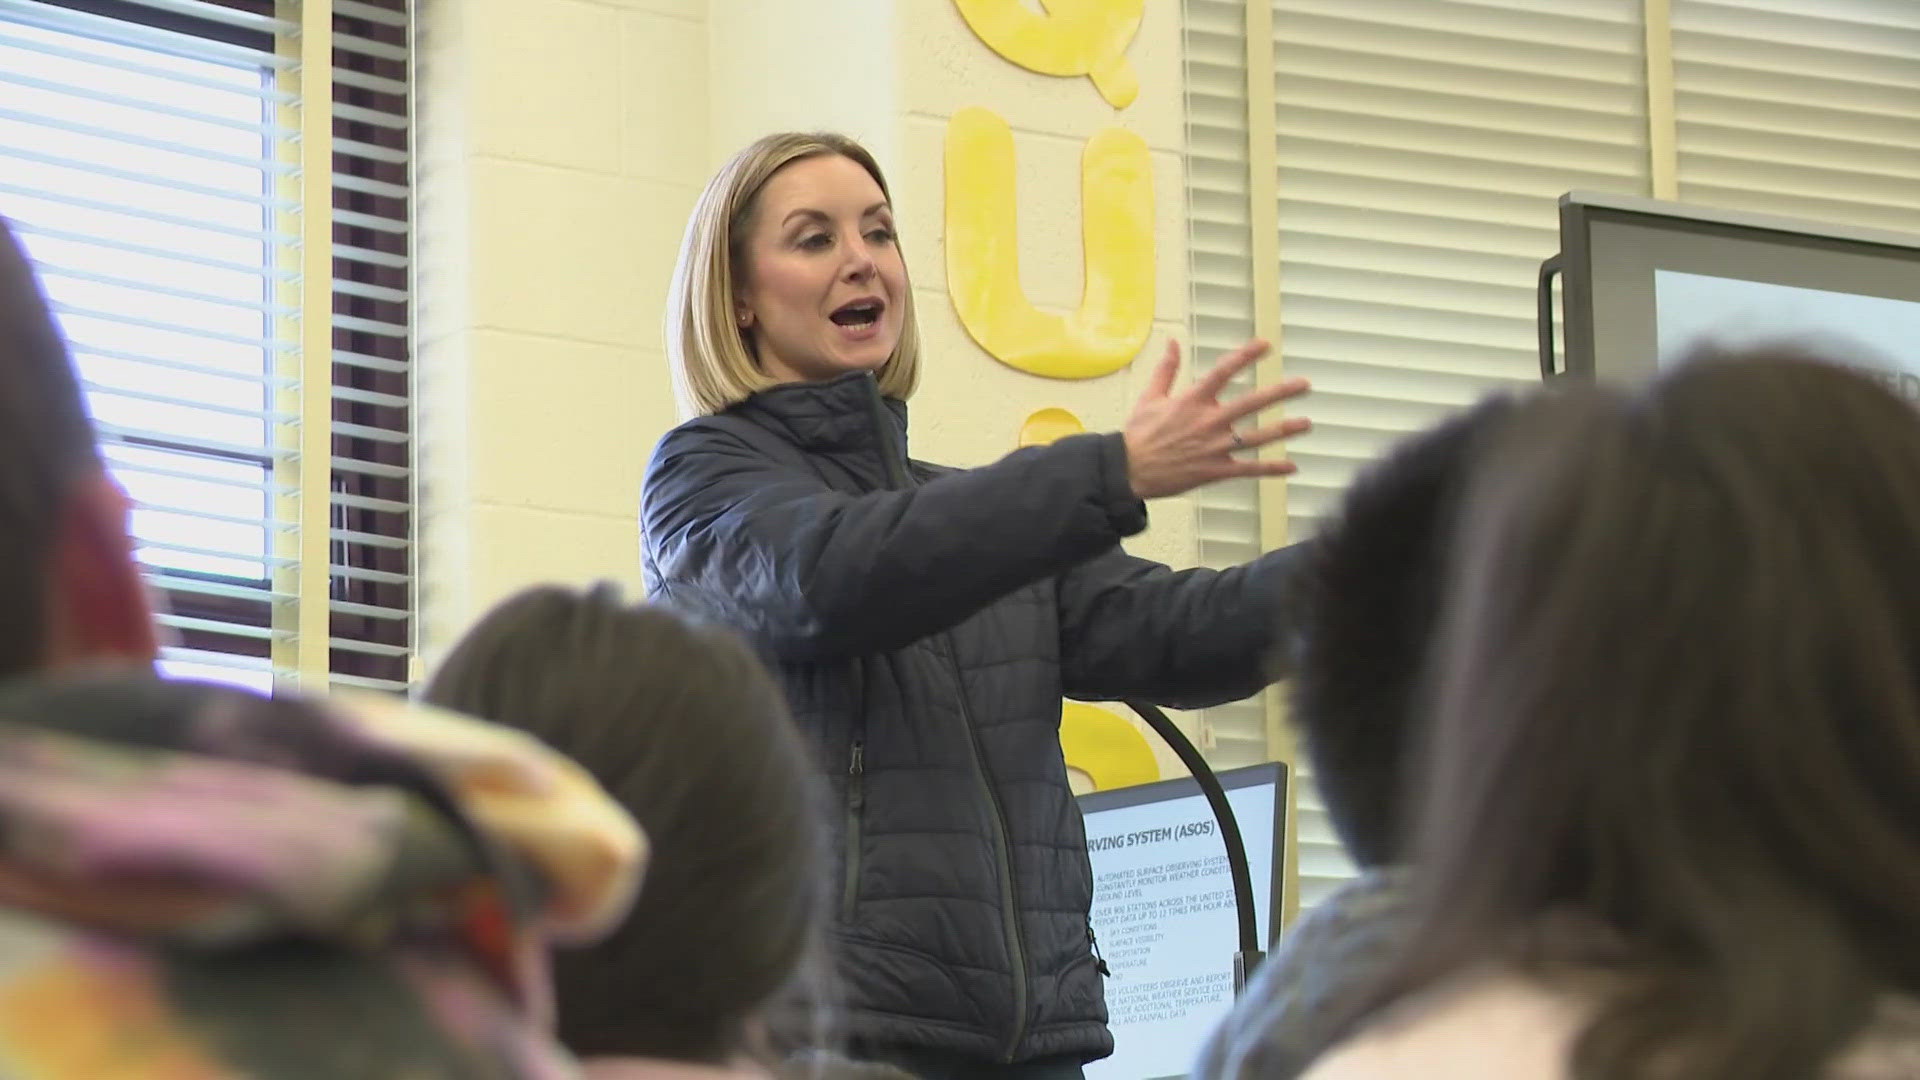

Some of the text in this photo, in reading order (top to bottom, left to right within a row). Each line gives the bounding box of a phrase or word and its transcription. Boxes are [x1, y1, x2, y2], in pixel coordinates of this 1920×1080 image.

[1127, 827, 1172, 847] SYSTEM
[1175, 819, 1215, 842] (ASOS)
[1096, 879, 1136, 892] CONSTANTLY
[1137, 875, 1167, 887] MONITOR
[1169, 870, 1200, 882] WEATHER
[1097, 869, 1135, 882] AUTOMATED
[1136, 864, 1164, 878] SURFACE
[1165, 859, 1203, 873] OBSERVING
[1124, 888, 1143, 899] LEVEL
[1126, 900, 1157, 912] STATIONS
[1159, 896, 1184, 908] ACROSS
[1185, 894, 1198, 904] THE
[1199, 890, 1225, 902] UNITED
[1094, 914, 1119, 926] REPORT
[1120, 913, 1137, 923] DATA
[1138, 911, 1147, 921] UP
[1148, 909, 1158, 920] TO
[1159, 908, 1167, 918] 12
[1168, 905, 1188, 916] TIMES
[1189, 903, 1202, 913] PER
[1203, 900, 1222, 911] HOUR
[1121, 923, 1157, 935] CONDITIONS
[1118, 982, 1159, 995] VOLUNTEERS
[1190, 975, 1205, 986] AND
[1205, 972, 1231, 983] REPORT
[1151, 989, 1182, 1001] WEATHER
[1123, 1015, 1138, 1025] AND
[1169, 1008, 1187, 1019] DATA
